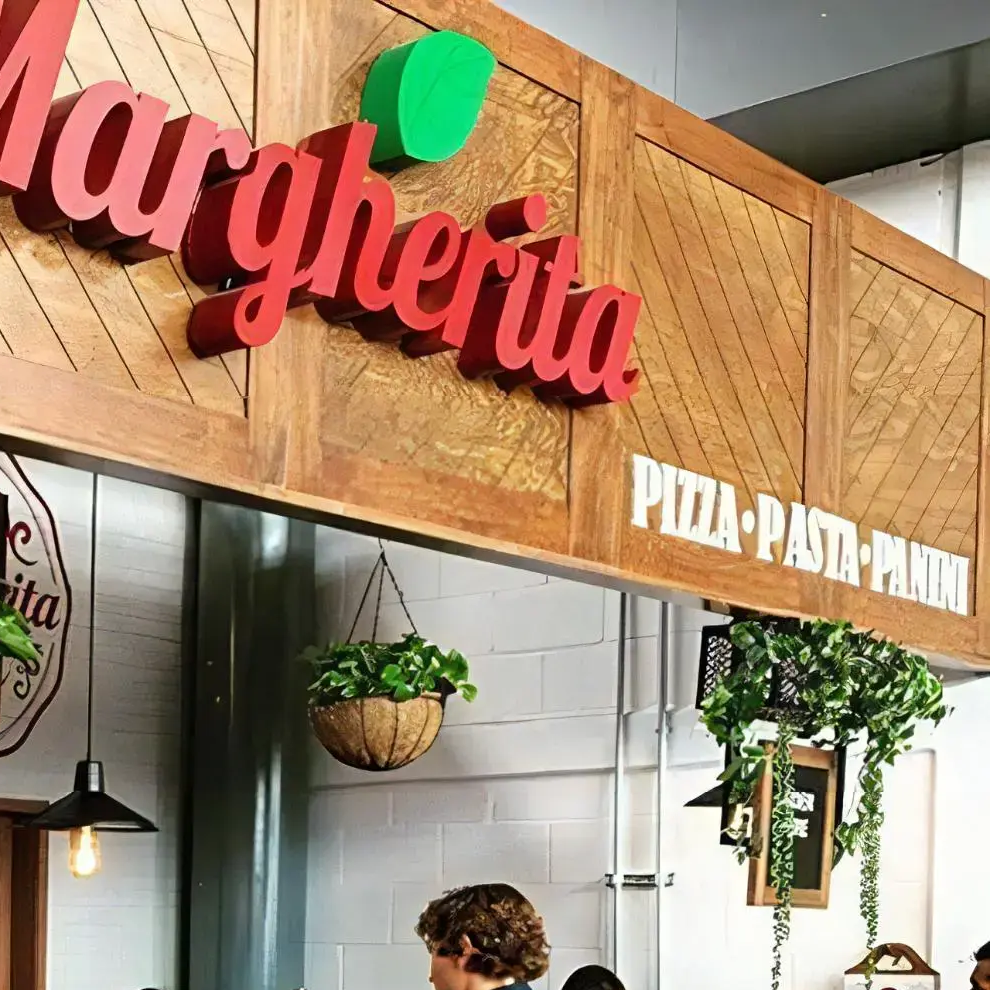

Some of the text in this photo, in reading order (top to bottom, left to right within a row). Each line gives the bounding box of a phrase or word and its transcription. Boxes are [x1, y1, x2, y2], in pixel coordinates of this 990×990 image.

[630, 452, 971, 617] PIZZA PASTA PANINI
